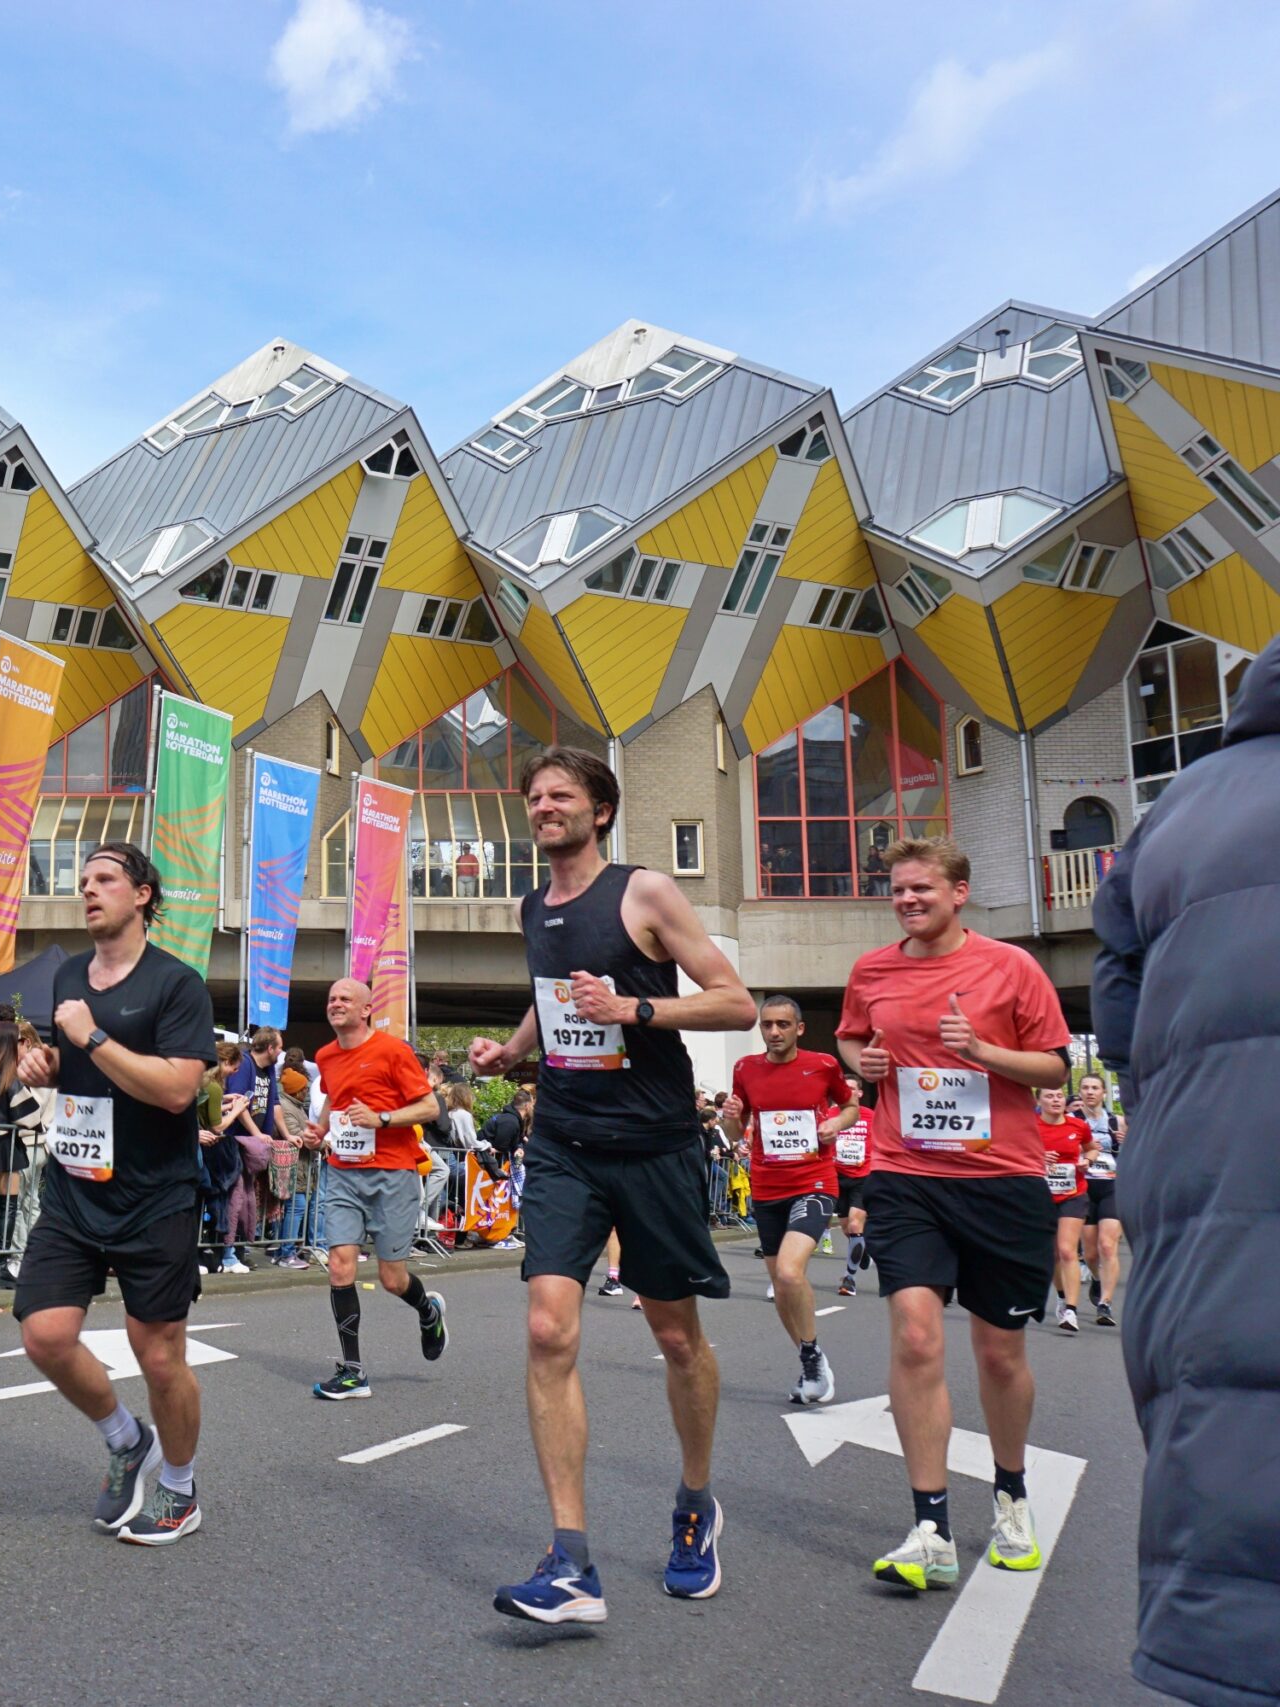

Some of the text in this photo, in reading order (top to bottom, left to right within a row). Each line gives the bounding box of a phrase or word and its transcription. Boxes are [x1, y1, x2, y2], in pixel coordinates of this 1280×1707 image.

[166, 729, 220, 754] MARATHON
[165, 740, 224, 765] ROTTERDAM
[259, 796, 308, 816] ROTTERDAM
[260, 787, 307, 807] MARATHON
[361, 815, 400, 833] ROTTERDAM
[362, 807, 400, 825] MARATHON
[564, 1013, 587, 1024] ROB
[553, 1028, 606, 1046] 19727
[942, 1077, 966, 1087] NN
[77, 1105, 94, 1115] NN
[926, 1100, 957, 1110] SAM
[912, 1113, 976, 1131] 23767
[336, 1140, 365, 1150] 11337
[770, 1139, 809, 1149] 12650
[837, 1133, 867, 1141] anker
[56, 1141, 101, 1159] 12072
